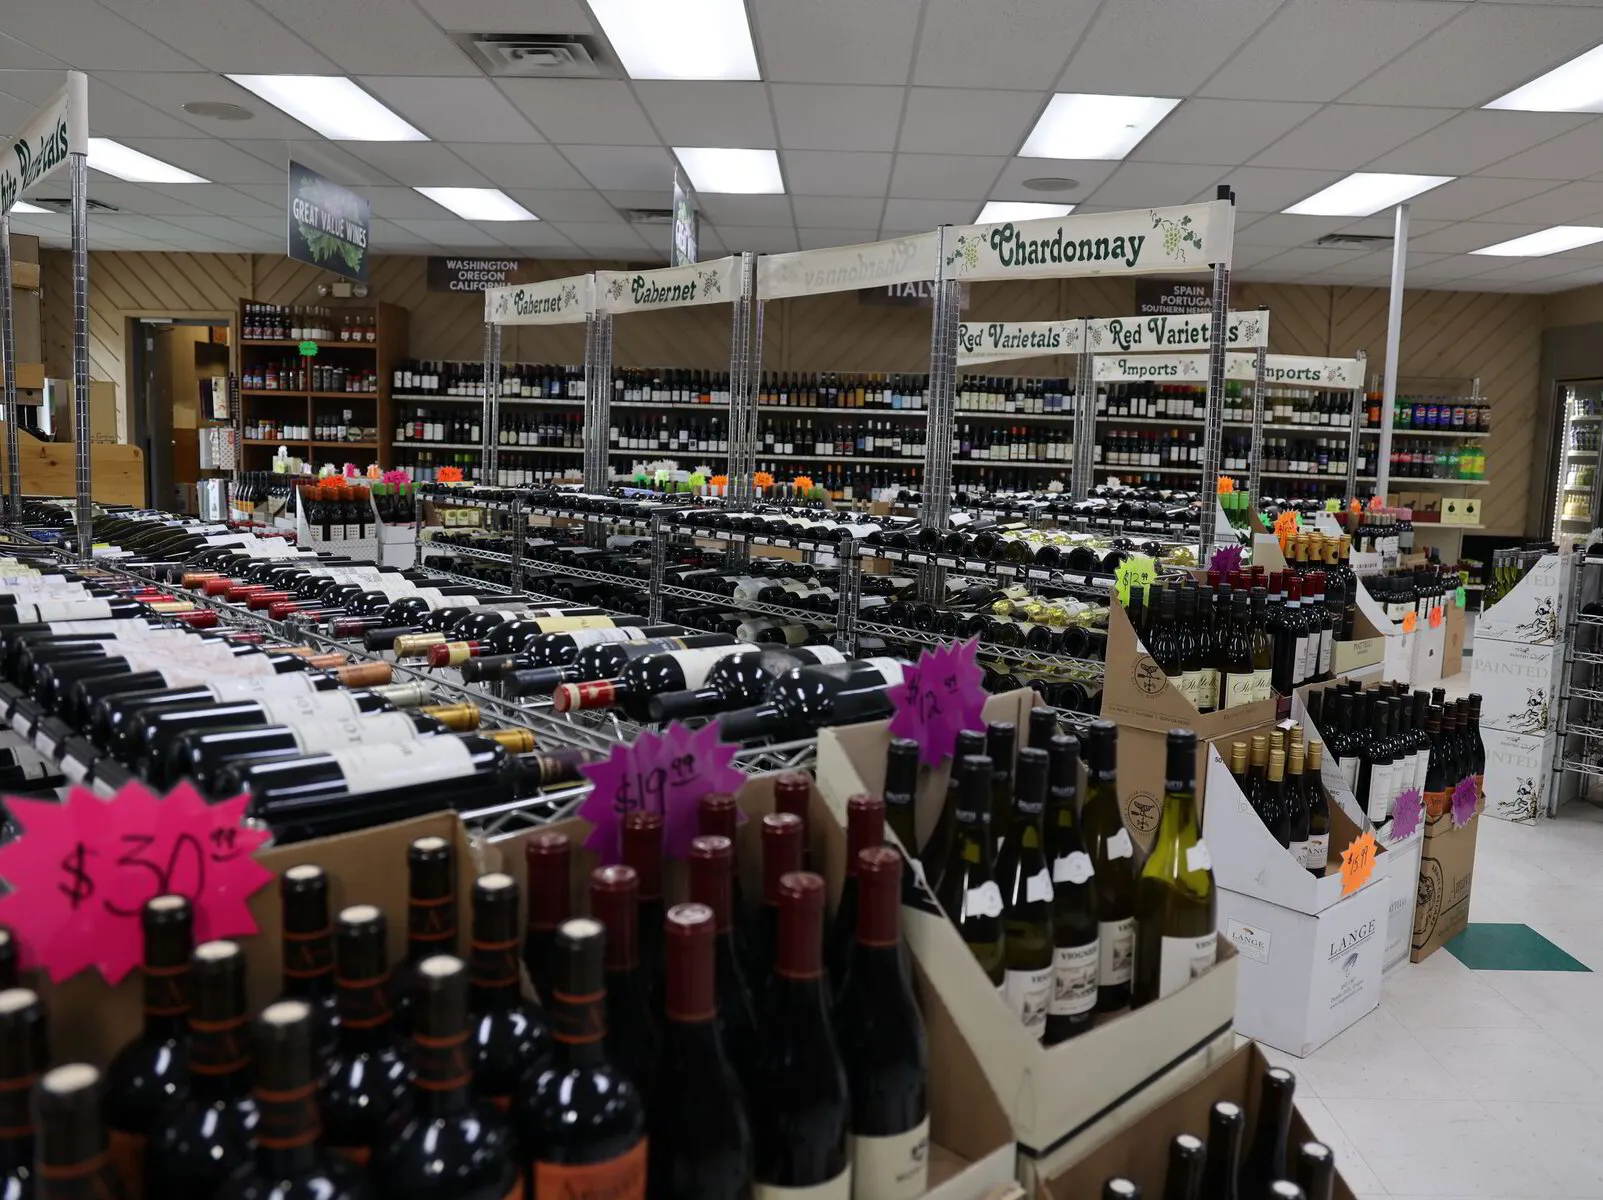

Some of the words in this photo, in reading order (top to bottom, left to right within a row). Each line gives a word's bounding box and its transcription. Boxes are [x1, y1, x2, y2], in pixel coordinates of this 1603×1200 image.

[0, 168, 17, 216] hite
[292, 197, 319, 228] GREAT
[321, 210, 344, 238] VALUE
[346, 220, 367, 248] WINES
[990, 223, 1146, 268] Chardonnay
[446, 260, 518, 271] WASHINGTON
[458, 271, 505, 281] OREGON
[631, 275, 697, 304] Cabernet
[1160, 295, 1213, 307] PORTUGA
[1173, 285, 1205, 296] SPAIN
[514, 289, 562, 315] Cabernet
[1141, 304, 1185, 314] SOUTHERN
[959, 324, 984, 353] Red
[988, 323, 1061, 349] Varietals
[1109, 319, 1142, 351] Red
[1147, 317, 1239, 346] Variets
[1118, 359, 1178, 379] Imports
[1475, 659, 1548, 679] PAINTED
[1231, 931, 1265, 950] LANGE
[1329, 919, 1377, 958] LANGE
